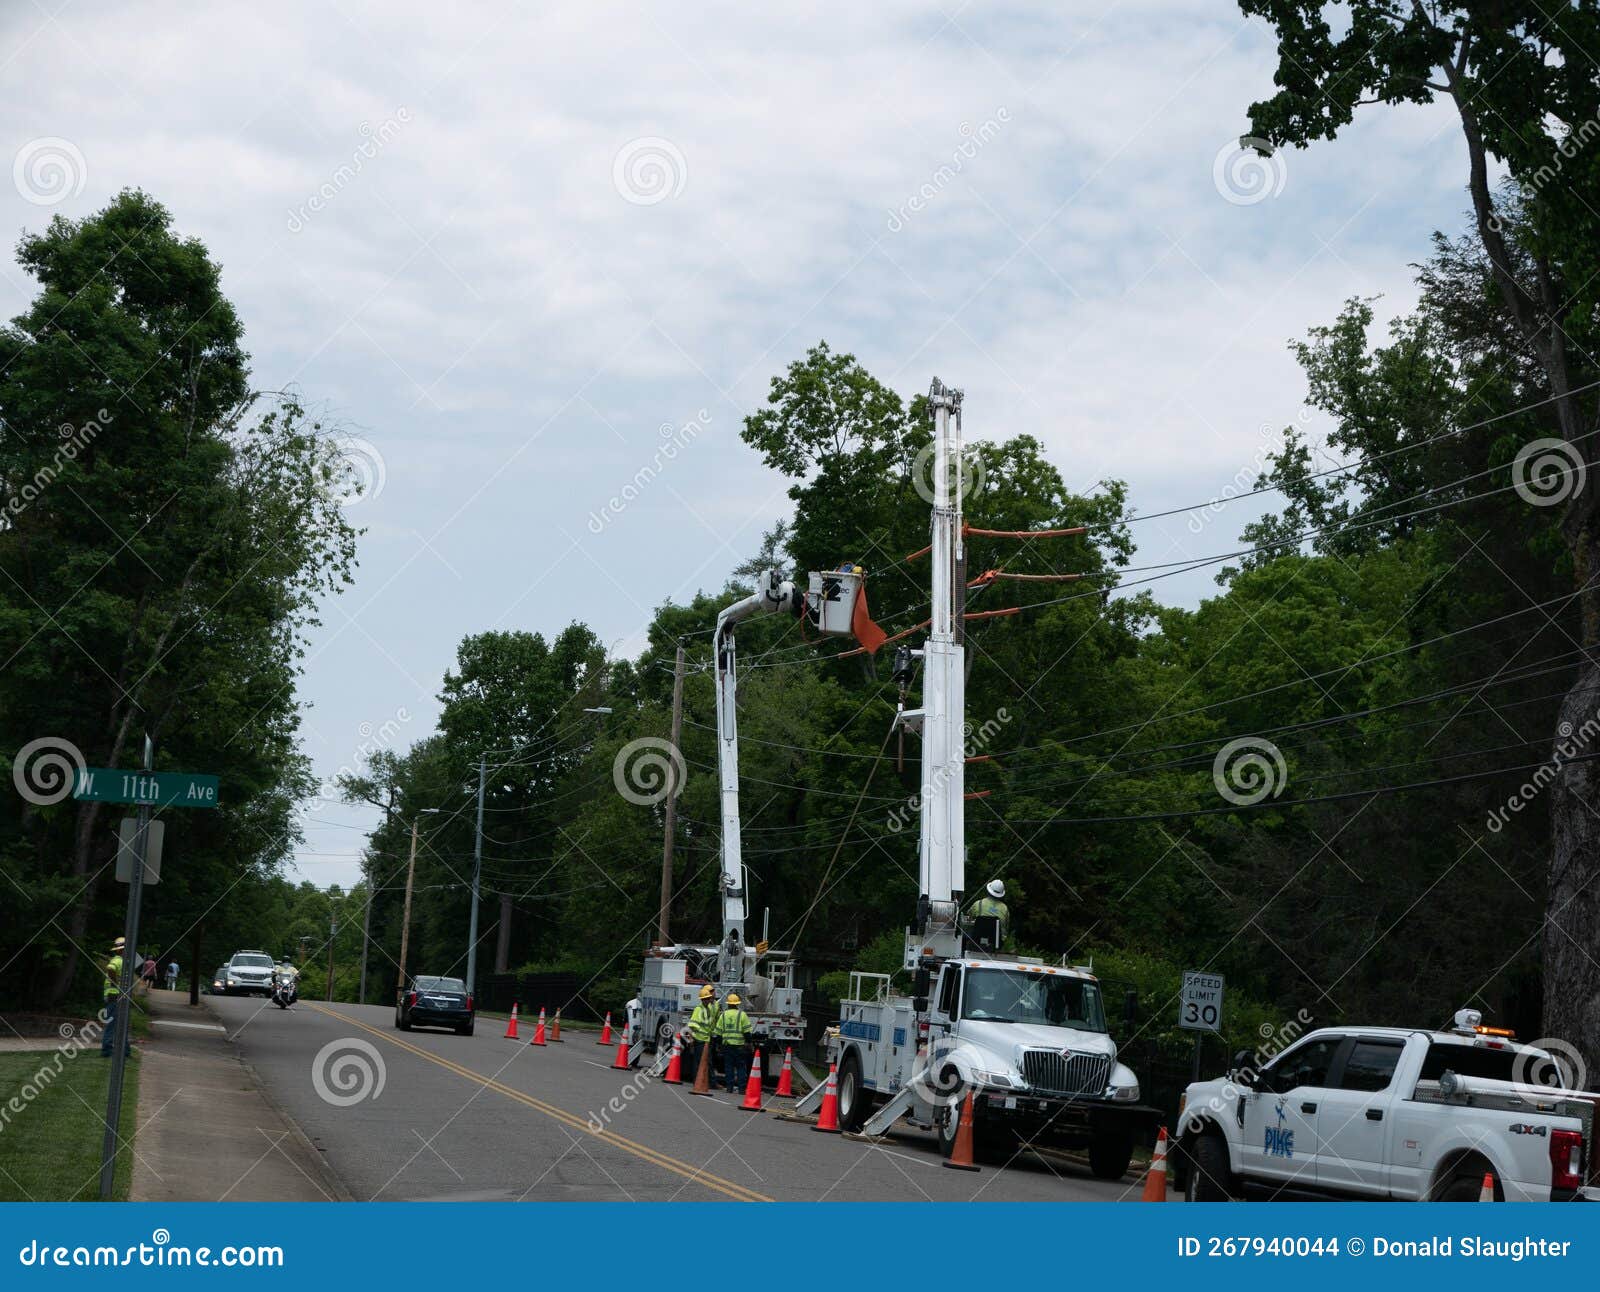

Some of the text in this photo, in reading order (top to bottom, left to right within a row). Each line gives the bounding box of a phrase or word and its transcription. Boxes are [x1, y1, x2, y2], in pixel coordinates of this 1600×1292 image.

[79, 771, 214, 800] W. 11th Ave
[1187, 976, 1221, 989] SPEED
[1188, 990, 1216, 1001] LIMIT
[1184, 1002, 1217, 1025] 30
[1264, 1126, 1294, 1158] PIKE
